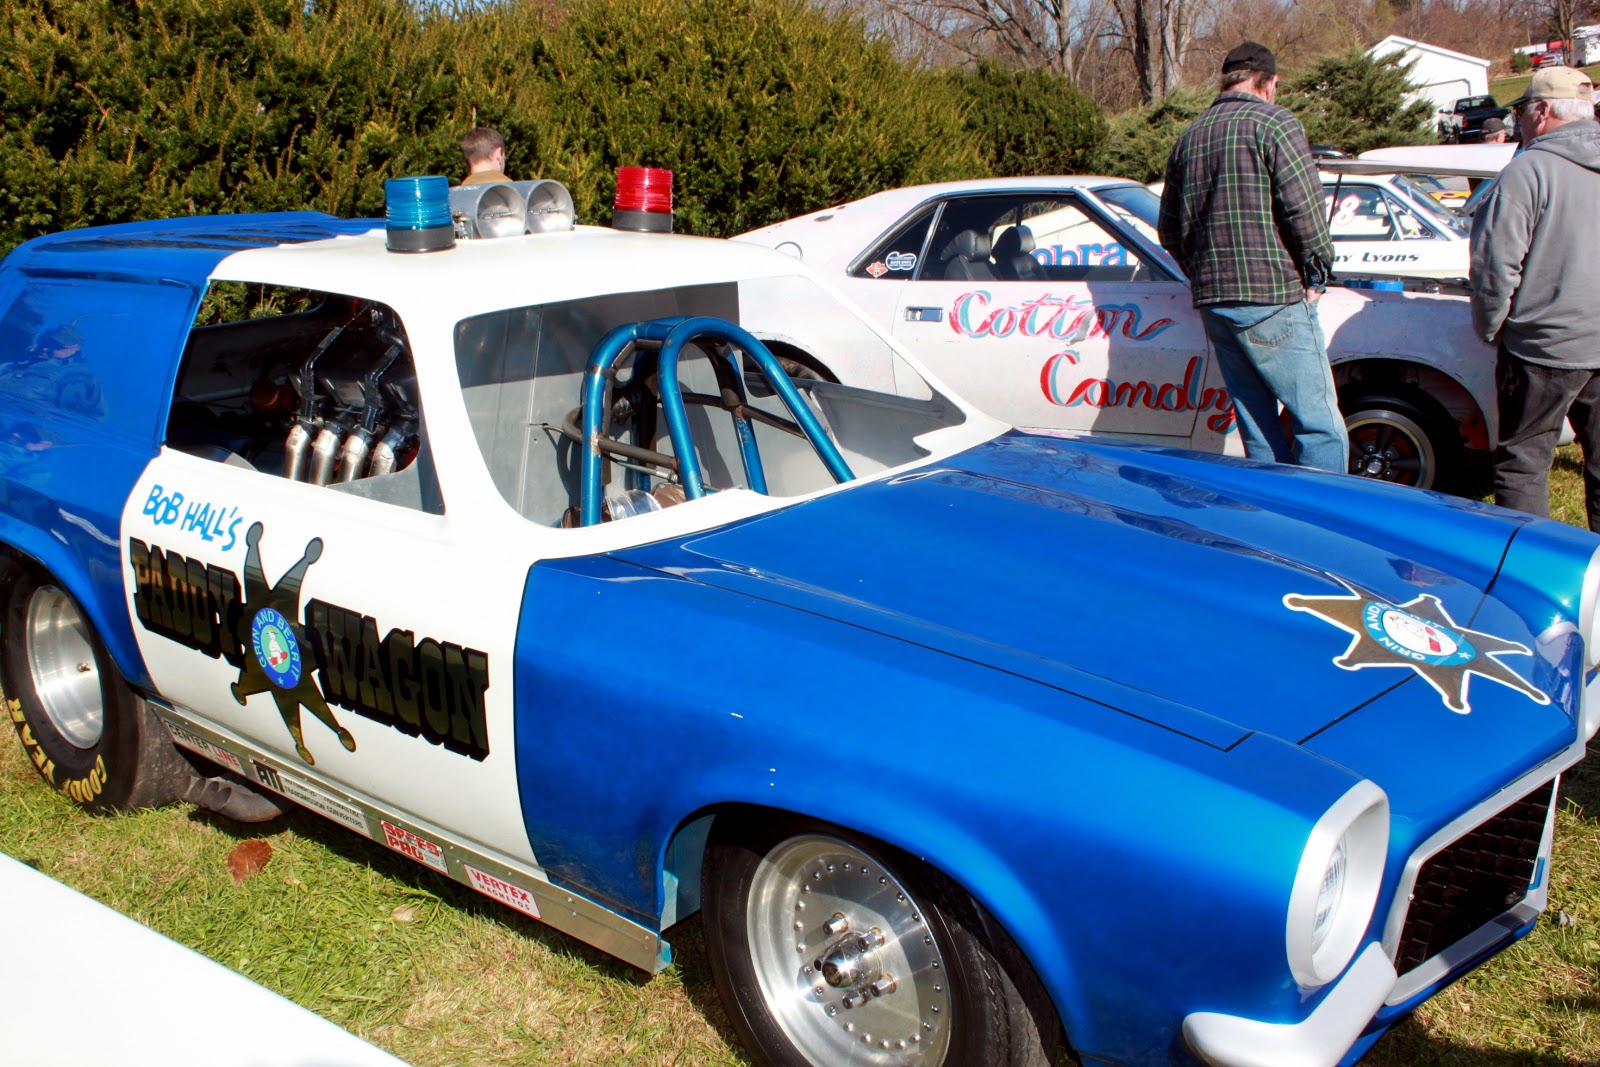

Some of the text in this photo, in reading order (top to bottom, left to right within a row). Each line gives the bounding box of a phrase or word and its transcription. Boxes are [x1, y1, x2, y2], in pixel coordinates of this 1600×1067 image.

[1029, 242, 1128, 266] obra
[1362, 252, 1419, 262] Lyons
[949, 290, 1176, 342] Cotton
[1040, 350, 1238, 434] Candy
[143, 484, 243, 552] BOB HALL'S
[130, 536, 247, 670] PADDY
[1366, 604, 1382, 632] AND
[251, 610, 300, 681] GRIN AND BEAR IT
[1378, 637, 1426, 661] GRIN
[304, 597, 490, 763] WAGON
[167, 723, 212, 753] CENTER
[212, 745, 240, 768] LINE
[383, 821, 440, 857] SPEED
[470, 869, 531, 904] VERTEX
[478, 883, 531, 911] MAGNETOS
